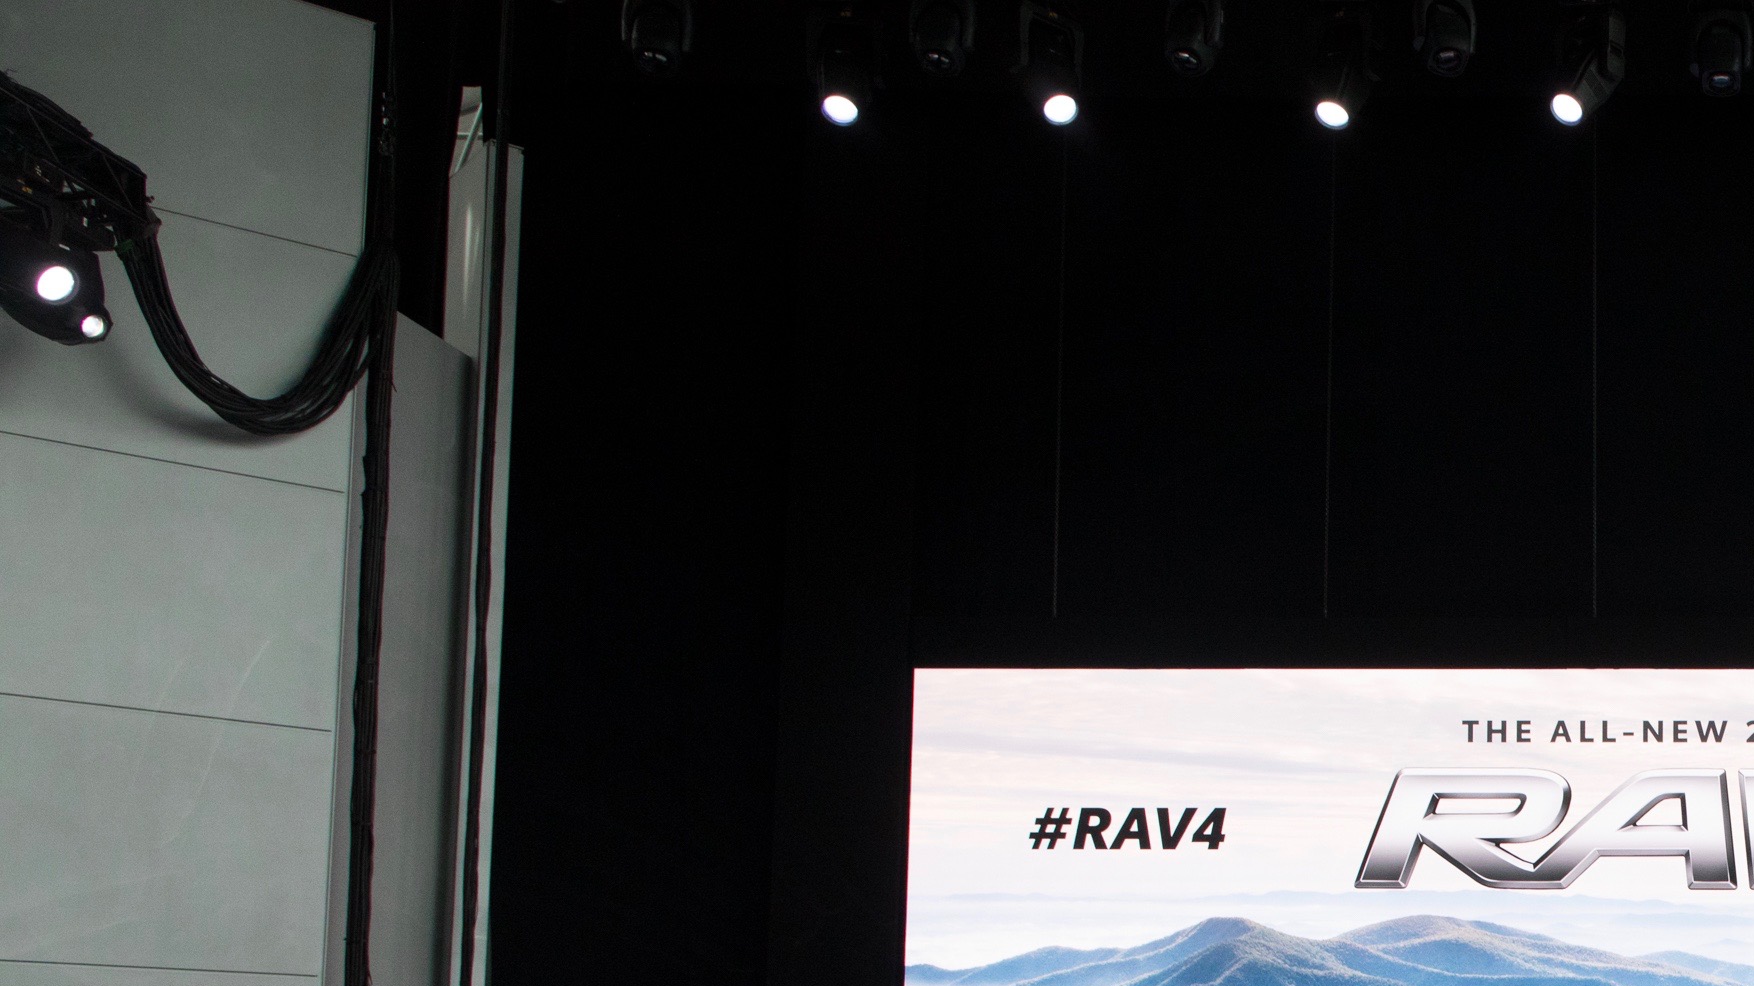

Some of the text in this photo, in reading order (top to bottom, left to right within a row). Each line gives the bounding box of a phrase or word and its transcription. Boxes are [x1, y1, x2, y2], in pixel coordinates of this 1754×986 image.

[1462, 720, 1532, 743] THE
[1551, 720, 1728, 743] ALL-NEW
[1029, 807, 1227, 849] #RAV4
